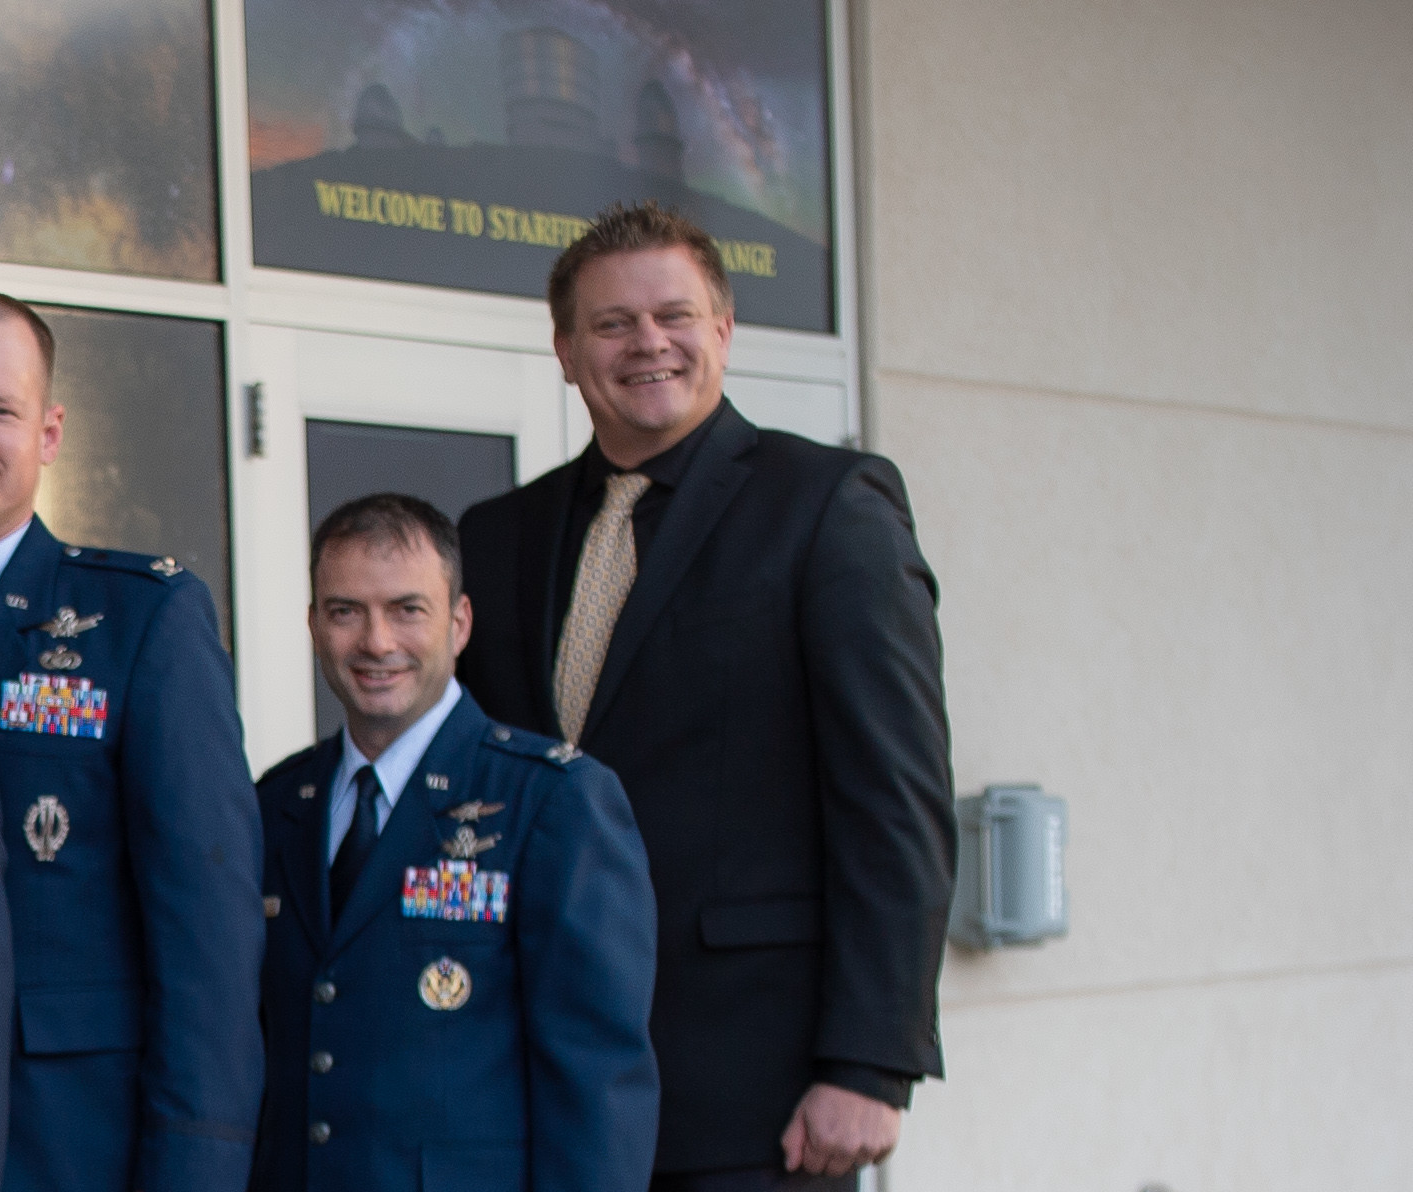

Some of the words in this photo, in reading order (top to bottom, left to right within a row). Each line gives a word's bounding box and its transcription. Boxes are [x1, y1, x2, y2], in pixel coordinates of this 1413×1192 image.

[315, 180, 446, 232] WELCOME
[451, 199, 484, 237] TO
[488, 204, 595, 248] STARFI
[713, 237, 777, 277] ANGE
